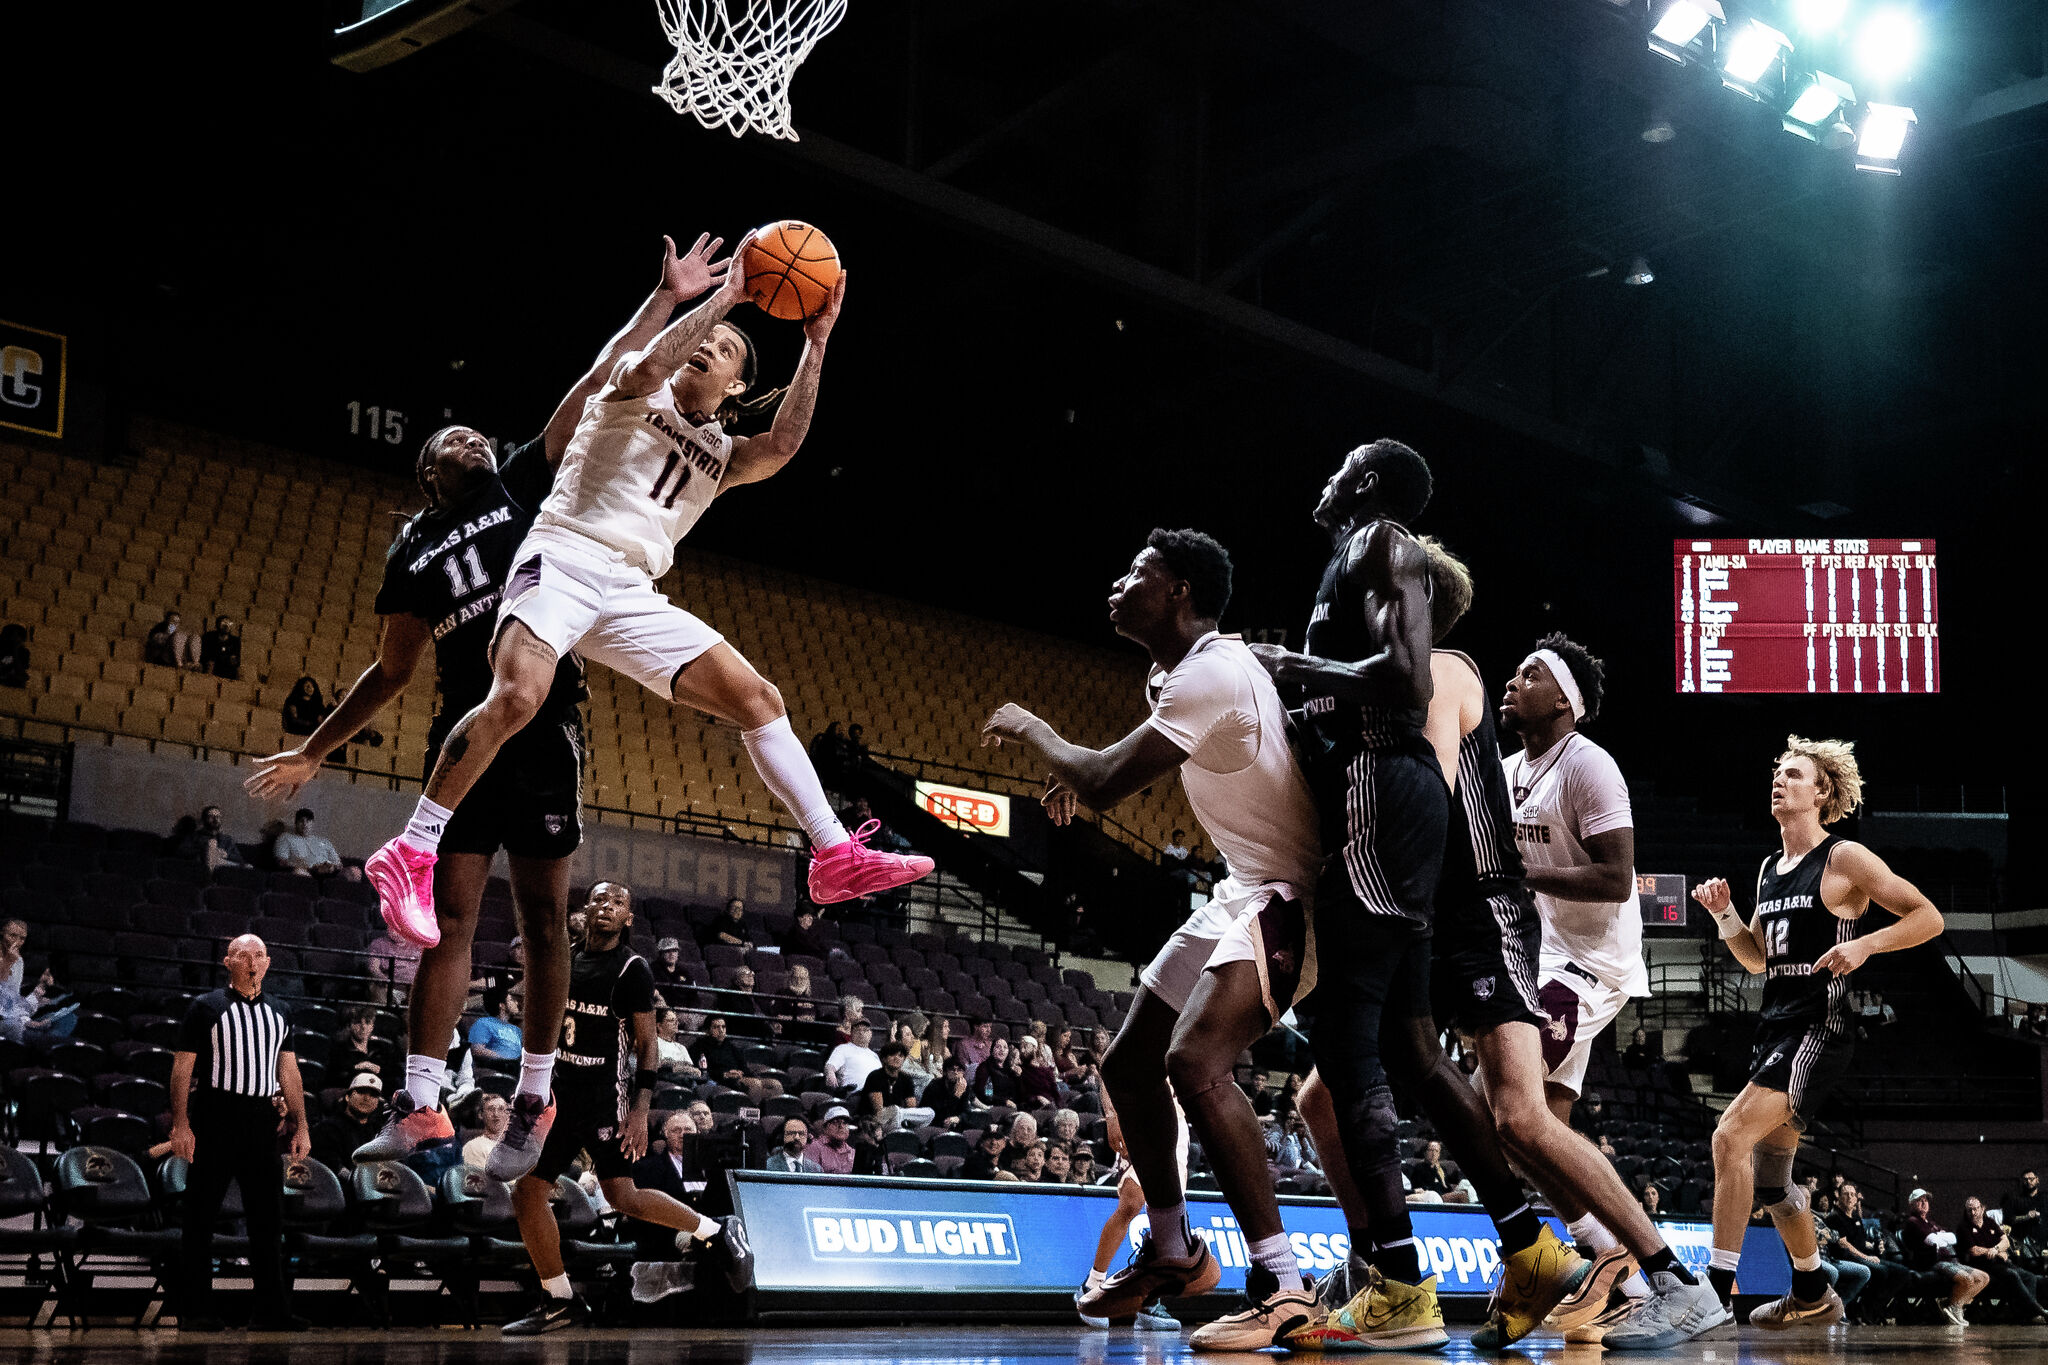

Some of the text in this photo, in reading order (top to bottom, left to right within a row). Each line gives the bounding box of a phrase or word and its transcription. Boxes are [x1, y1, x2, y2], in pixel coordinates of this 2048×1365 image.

[347, 401, 404, 445] 115
[649, 450, 691, 510] 11
[463, 506, 513, 539] A&M
[1749, 540, 1792, 554] PLAYER
[1833, 540, 1869, 554] STATS
[443, 544, 491, 599] 11
[1699, 555, 1747, 569] TAMU-SA
[1802, 555, 1816, 569] PF
[1821, 555, 1842, 569] PTS
[1844, 555, 1866, 569] REB
[1868, 555, 1889, 569] AST
[1892, 555, 1912, 569] STL
[1915, 555, 1936, 569] BLK
[1700, 623, 1727, 637] TXST
[1803, 623, 1818, 637] PF
[1822, 623, 1844, 637] PTS
[1846, 623, 1868, 637] REB
[1869, 623, 1891, 637] AST
[1893, 623, 1914, 637] STL
[1917, 623, 1938, 637] BLK
[1517, 823, 1551, 844] STATE
[1783, 895, 1814, 910] A&M
[1663, 905, 1678, 921] 16
[1765, 917, 1790, 959] 42
[577, 1002, 609, 1017] A&M
[813, 1217, 1009, 1256] BUD LIGHT
[1675, 1245, 1711, 1265] BUD
